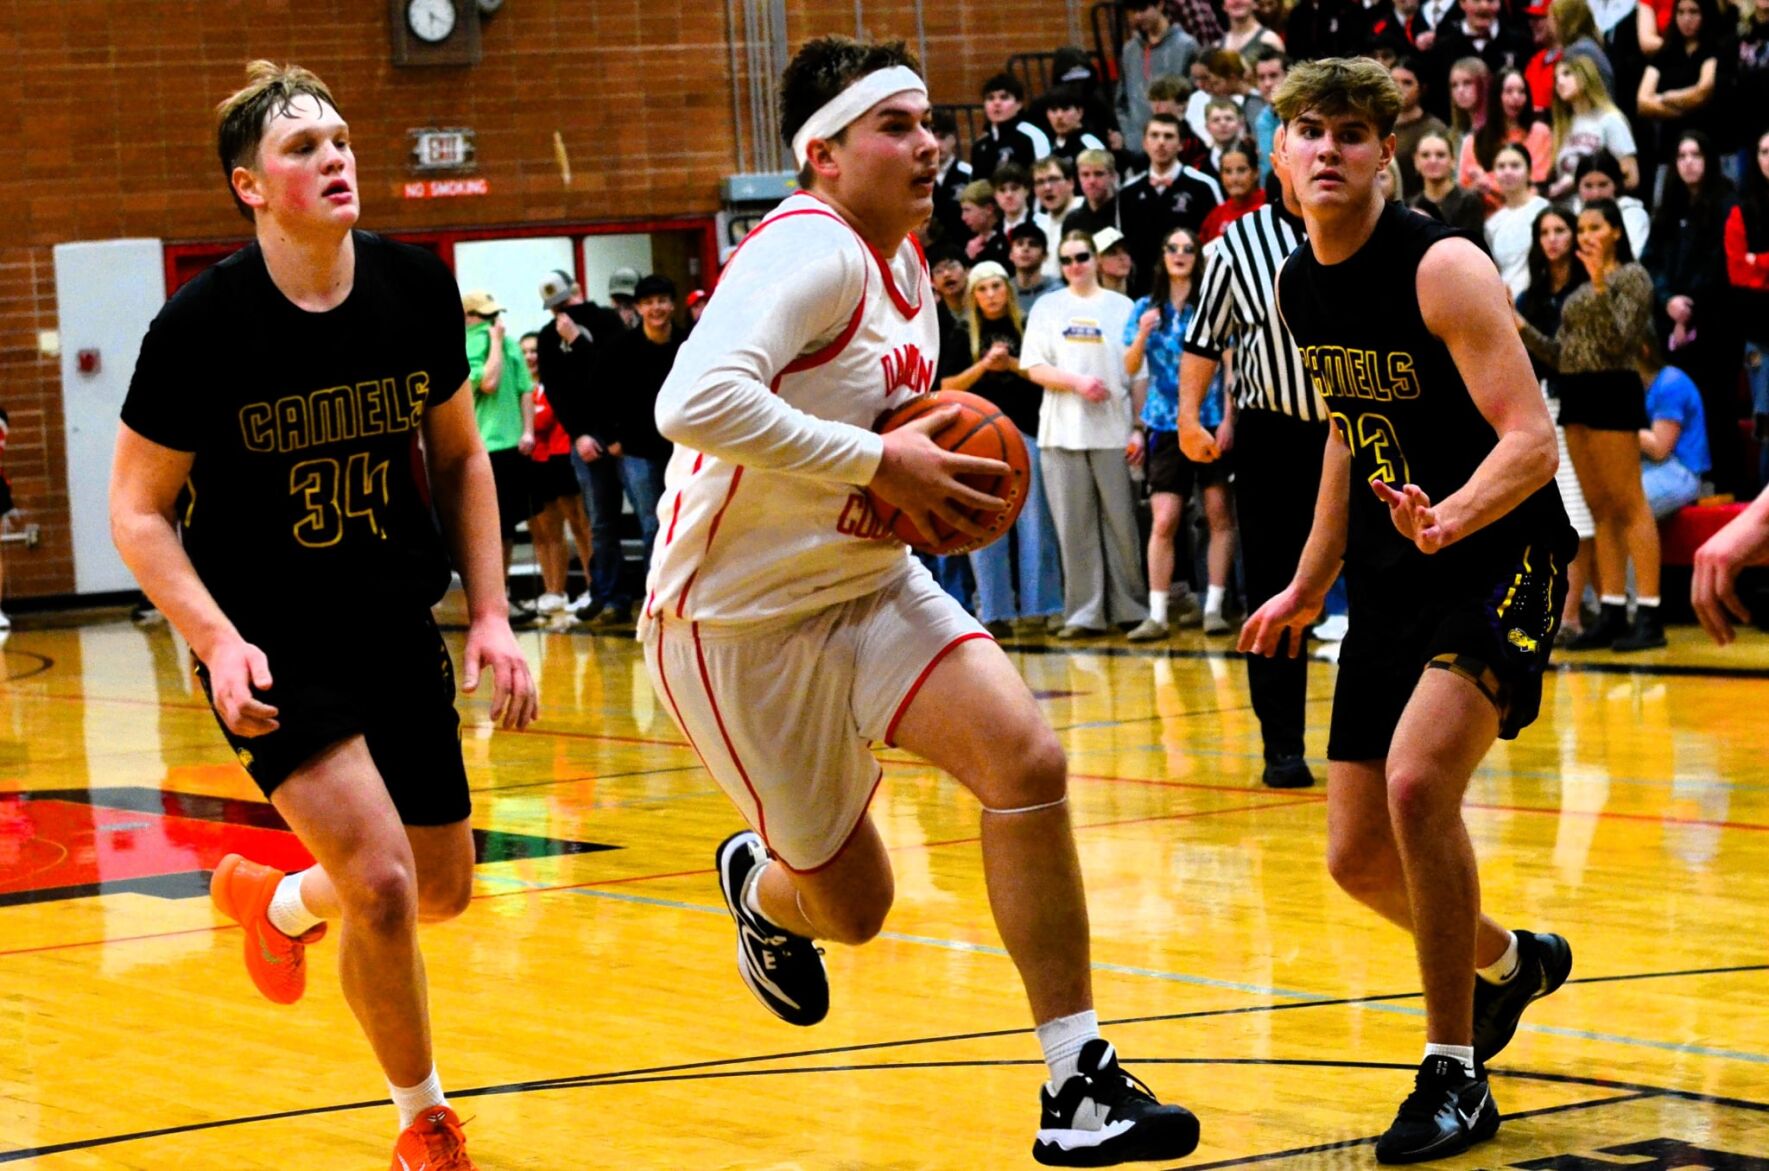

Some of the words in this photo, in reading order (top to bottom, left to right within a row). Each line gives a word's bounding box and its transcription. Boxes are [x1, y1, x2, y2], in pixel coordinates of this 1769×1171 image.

[404, 182, 425, 198] NO
[431, 179, 488, 197] SMOKING
[239, 370, 430, 452] CAMELS
[289, 452, 390, 548] 34
